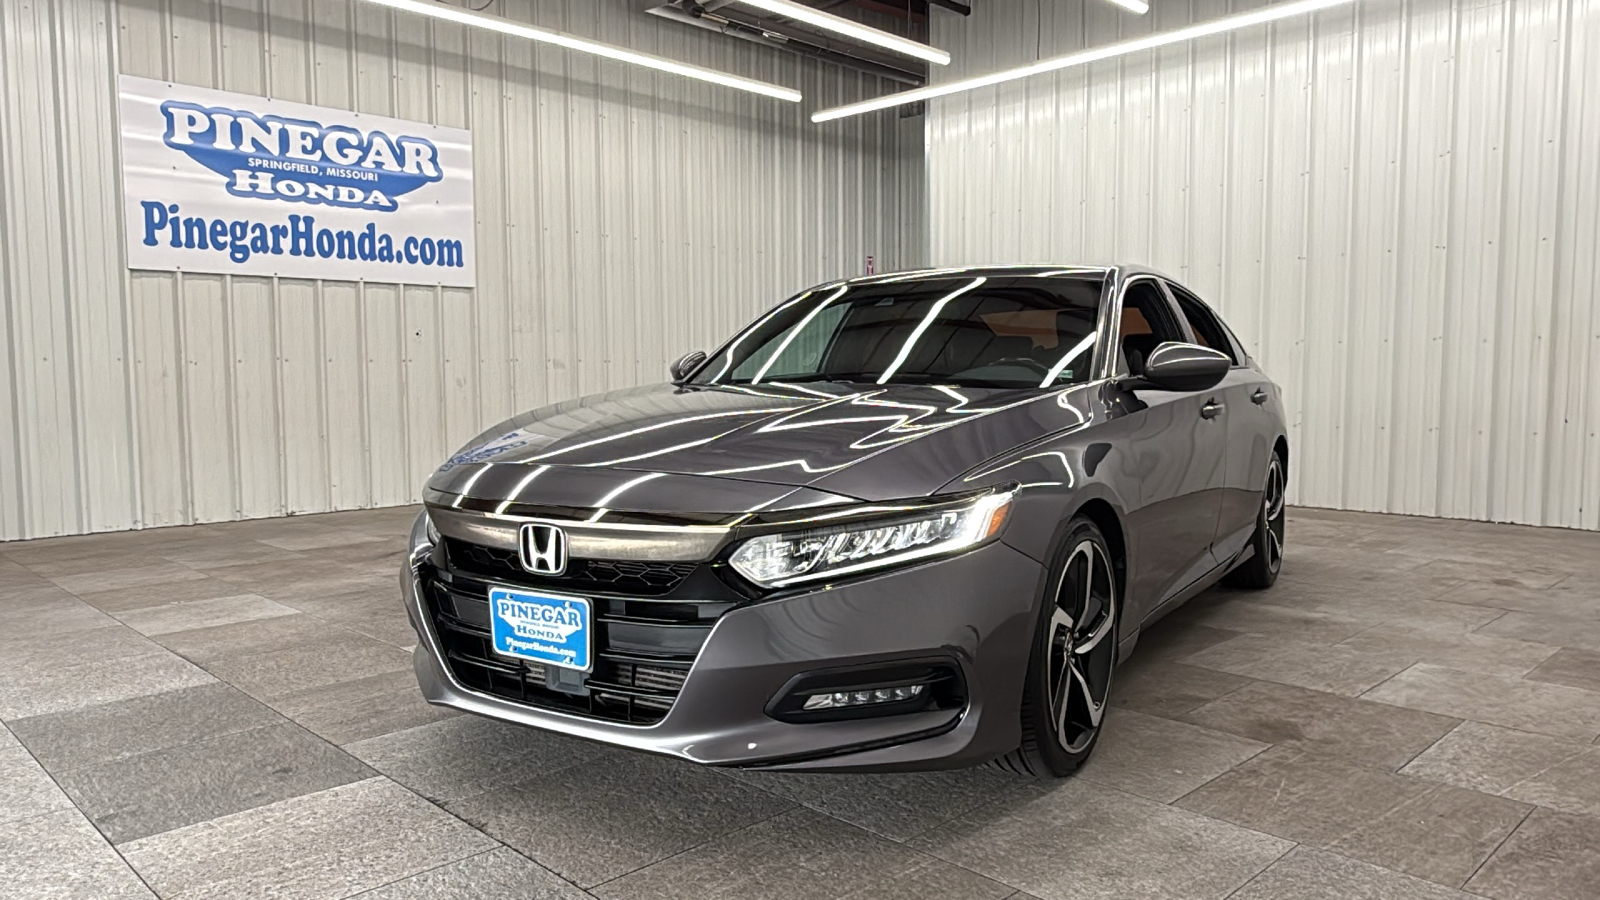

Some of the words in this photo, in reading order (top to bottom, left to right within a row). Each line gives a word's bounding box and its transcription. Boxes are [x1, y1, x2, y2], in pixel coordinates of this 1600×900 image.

[166, 106, 438, 178] PINEGAR
[248, 157, 323, 177] SPRINGFIELD,
[326, 167, 379, 182] MISSOURI
[232, 169, 393, 207] HONDA
[140, 200, 464, 268] PinegarHonda.com
[500, 602, 579, 627] PINEGAR
[516, 624, 564, 640] HONDA
